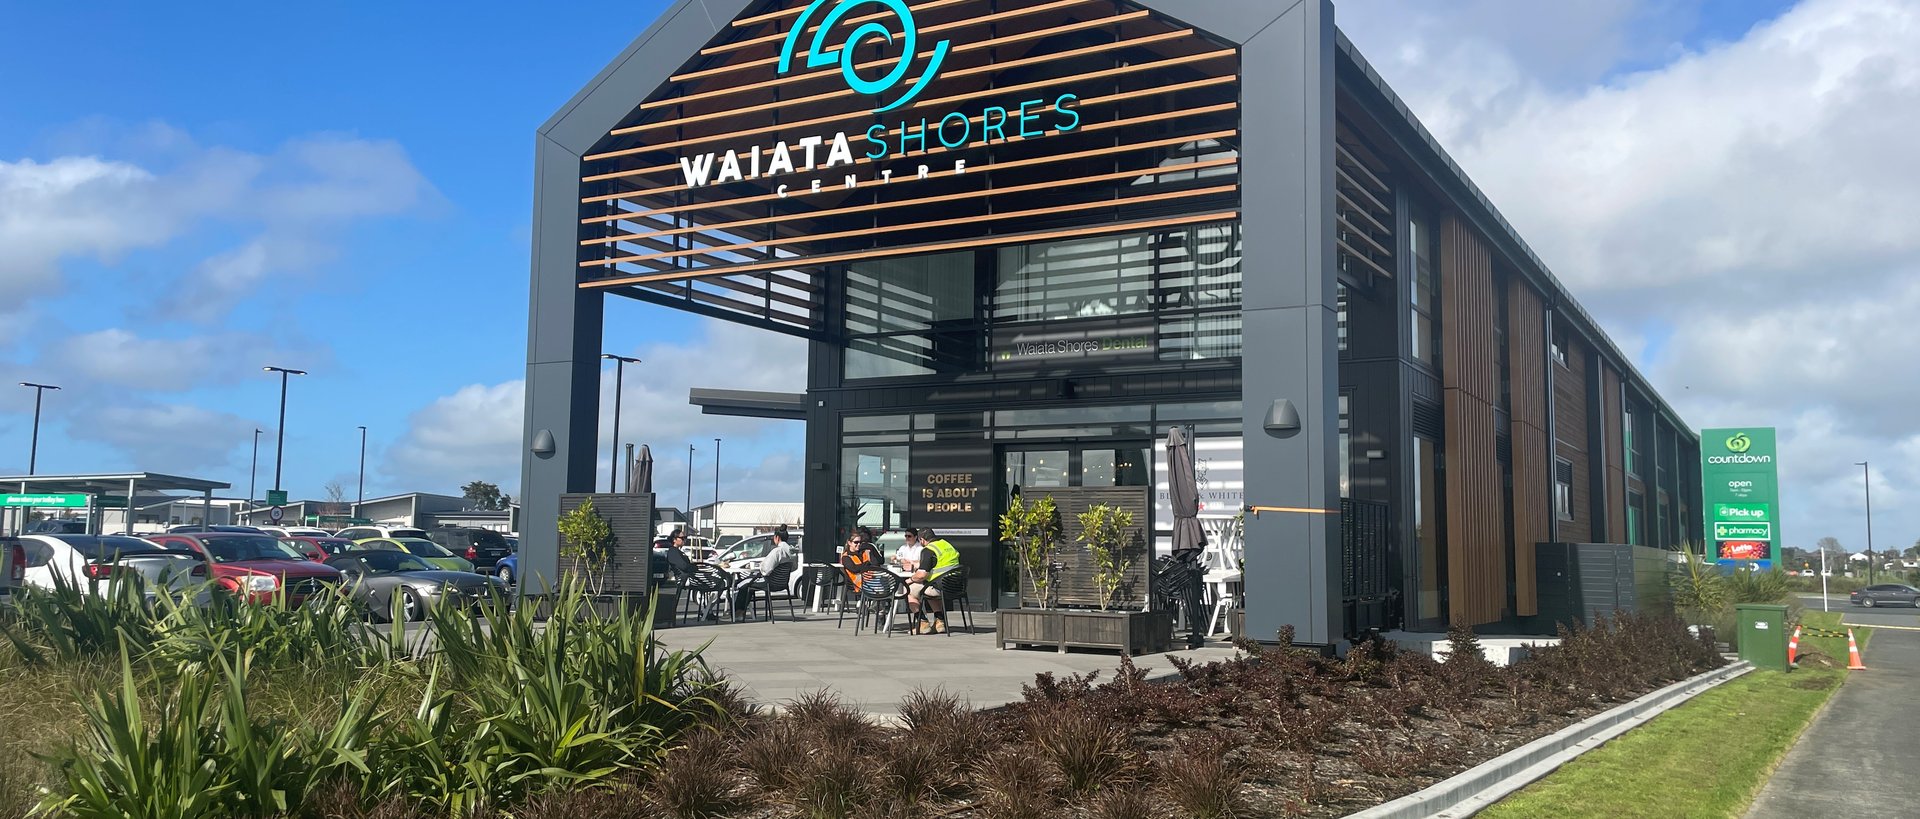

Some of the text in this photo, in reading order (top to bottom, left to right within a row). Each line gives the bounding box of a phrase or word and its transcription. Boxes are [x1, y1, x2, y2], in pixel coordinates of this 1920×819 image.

[679, 93, 1079, 188] WAIATA SHORES
[777, 159, 965, 198] CENTRE
[1017, 336, 1148, 356] Waiata Shores Dental
[1708, 453, 1770, 464] countdown
[927, 474, 972, 484] COFFEE
[1728, 480, 1752, 488] open
[922, 487, 977, 498] IS ABOUT
[927, 502, 972, 512] PEOPLE
[1729, 508, 1764, 518] Pick up
[1728, 526, 1767, 536] pharmacy
